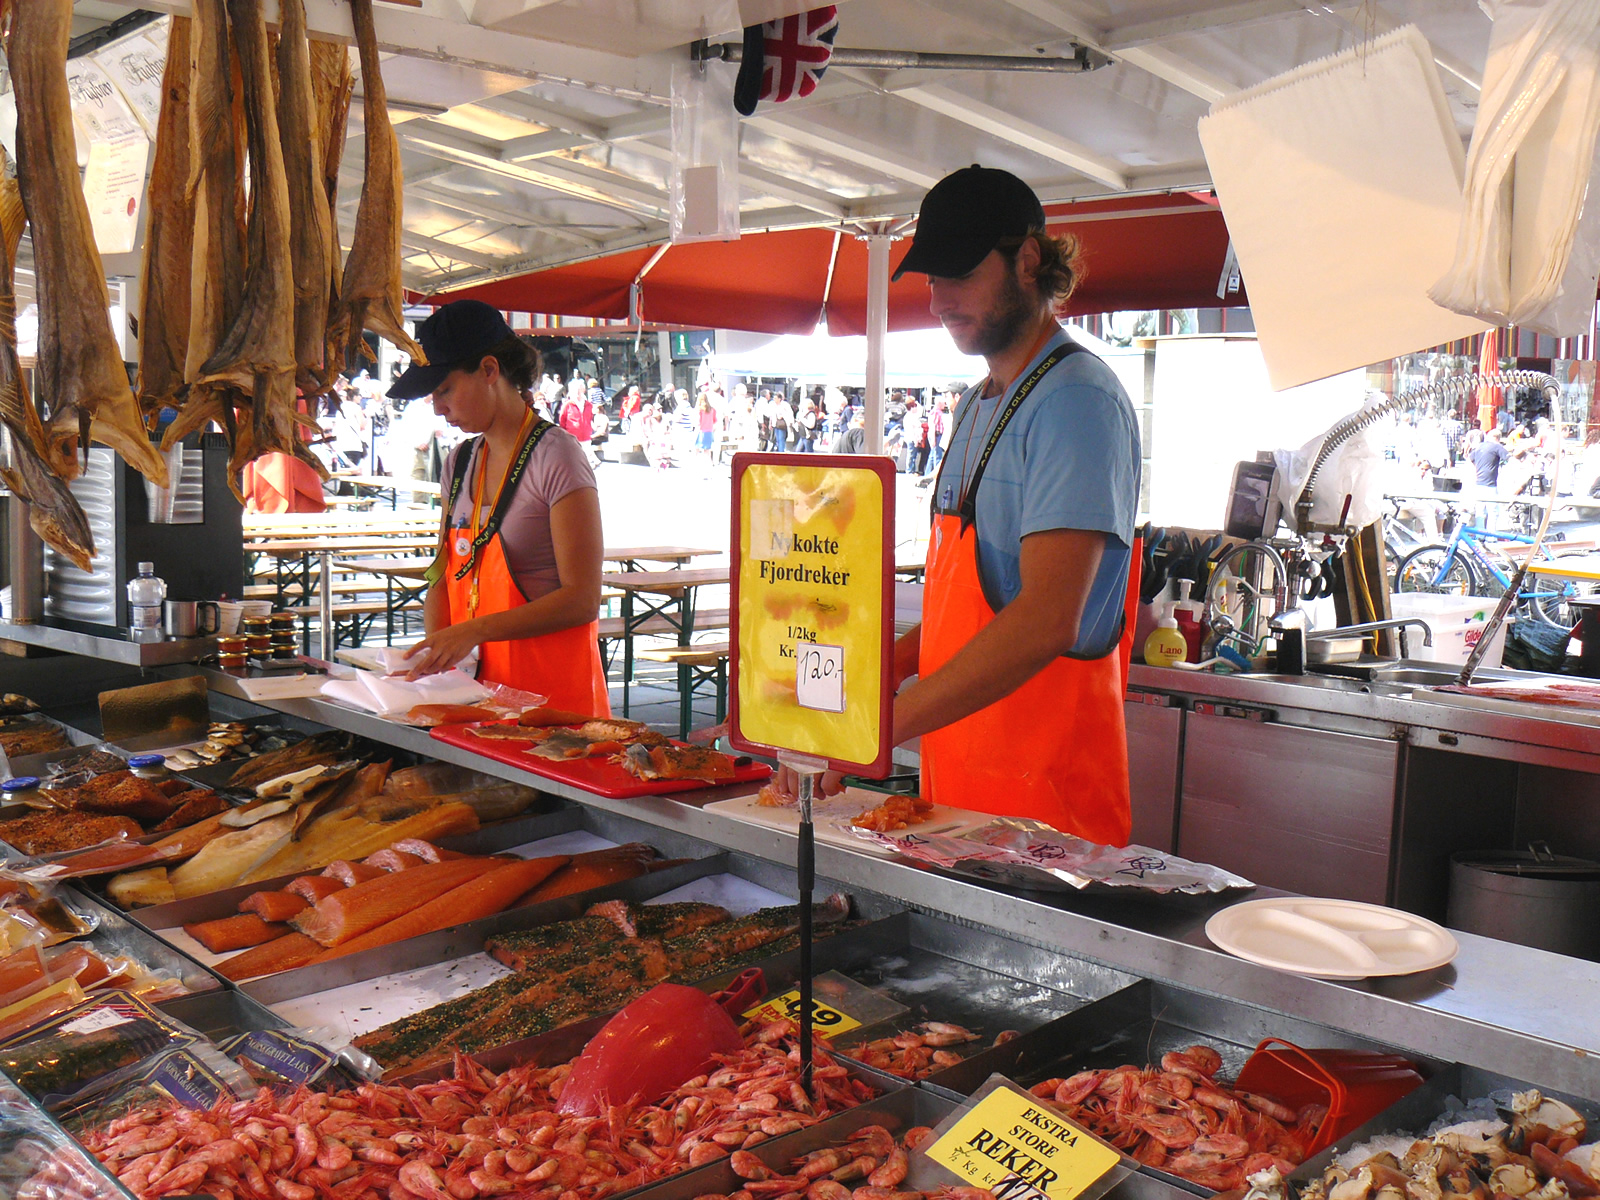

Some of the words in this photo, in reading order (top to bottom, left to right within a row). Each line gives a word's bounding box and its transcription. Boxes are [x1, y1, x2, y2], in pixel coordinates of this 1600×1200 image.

[981, 409, 1013, 467] AALESUND
[1011, 357, 1057, 406] OLJEKLEDE
[510, 436, 536, 483] AALESUND
[771, 532, 839, 560] Nykokte
[760, 561, 850, 586] Fjordreker
[787, 626, 816, 644] 1/2kg
[1159, 644, 1182, 655] Lano
[287, 1056, 312, 1074] LAKS
[1021, 1107, 1079, 1147] EKSTRA
[1008, 1125, 1059, 1158] STORE
[962, 1160, 978, 1176] Kg
[966, 1128, 1058, 1192] REKER
